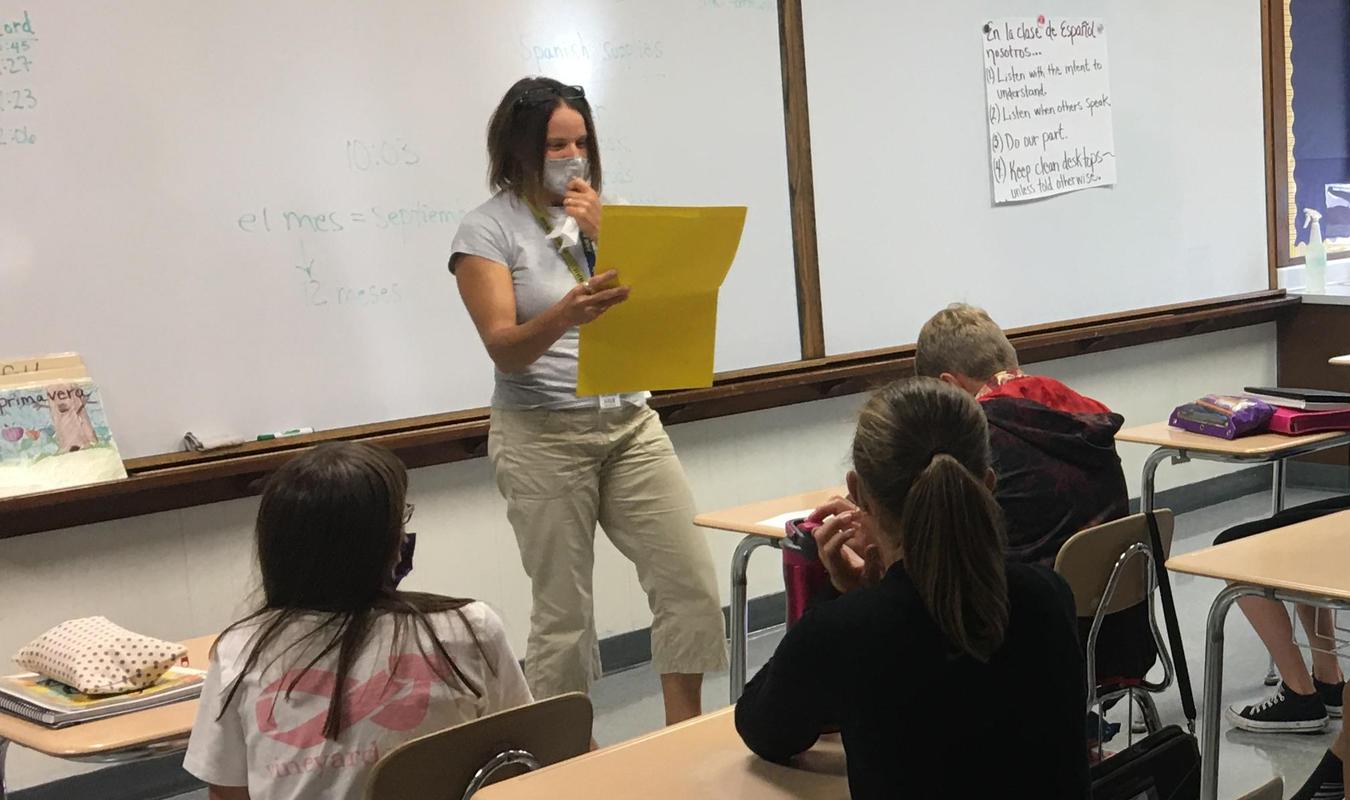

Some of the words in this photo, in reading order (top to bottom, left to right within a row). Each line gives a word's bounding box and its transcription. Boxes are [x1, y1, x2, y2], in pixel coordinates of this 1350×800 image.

[987, 20, 1000, 41] En
[1005, 22, 1014, 41] la
[1017, 24, 1042, 41] clase
[1046, 20, 1057, 41] de
[1061, 20, 1096, 45] Español
[997, 66, 1026, 83] Listen
[1029, 65, 1046, 79] with
[1048, 63, 1062, 77] the
[1093, 59, 1102, 71] to
[1002, 105, 1031, 121] Listen
[1034, 103, 1055, 116] when
[1057, 99, 1083, 113] others
[1005, 133, 1020, 150] Do
[1024, 135, 1038, 147] our
[345, 139, 421, 171] 10:03
[1009, 160, 1031, 182] Keep
[1035, 156, 1060, 175] clean
[1011, 182, 1036, 198] unless
[1038, 177, 1052, 192] told
[238, 207, 271, 232] el
[282, 211, 344, 232] mes
